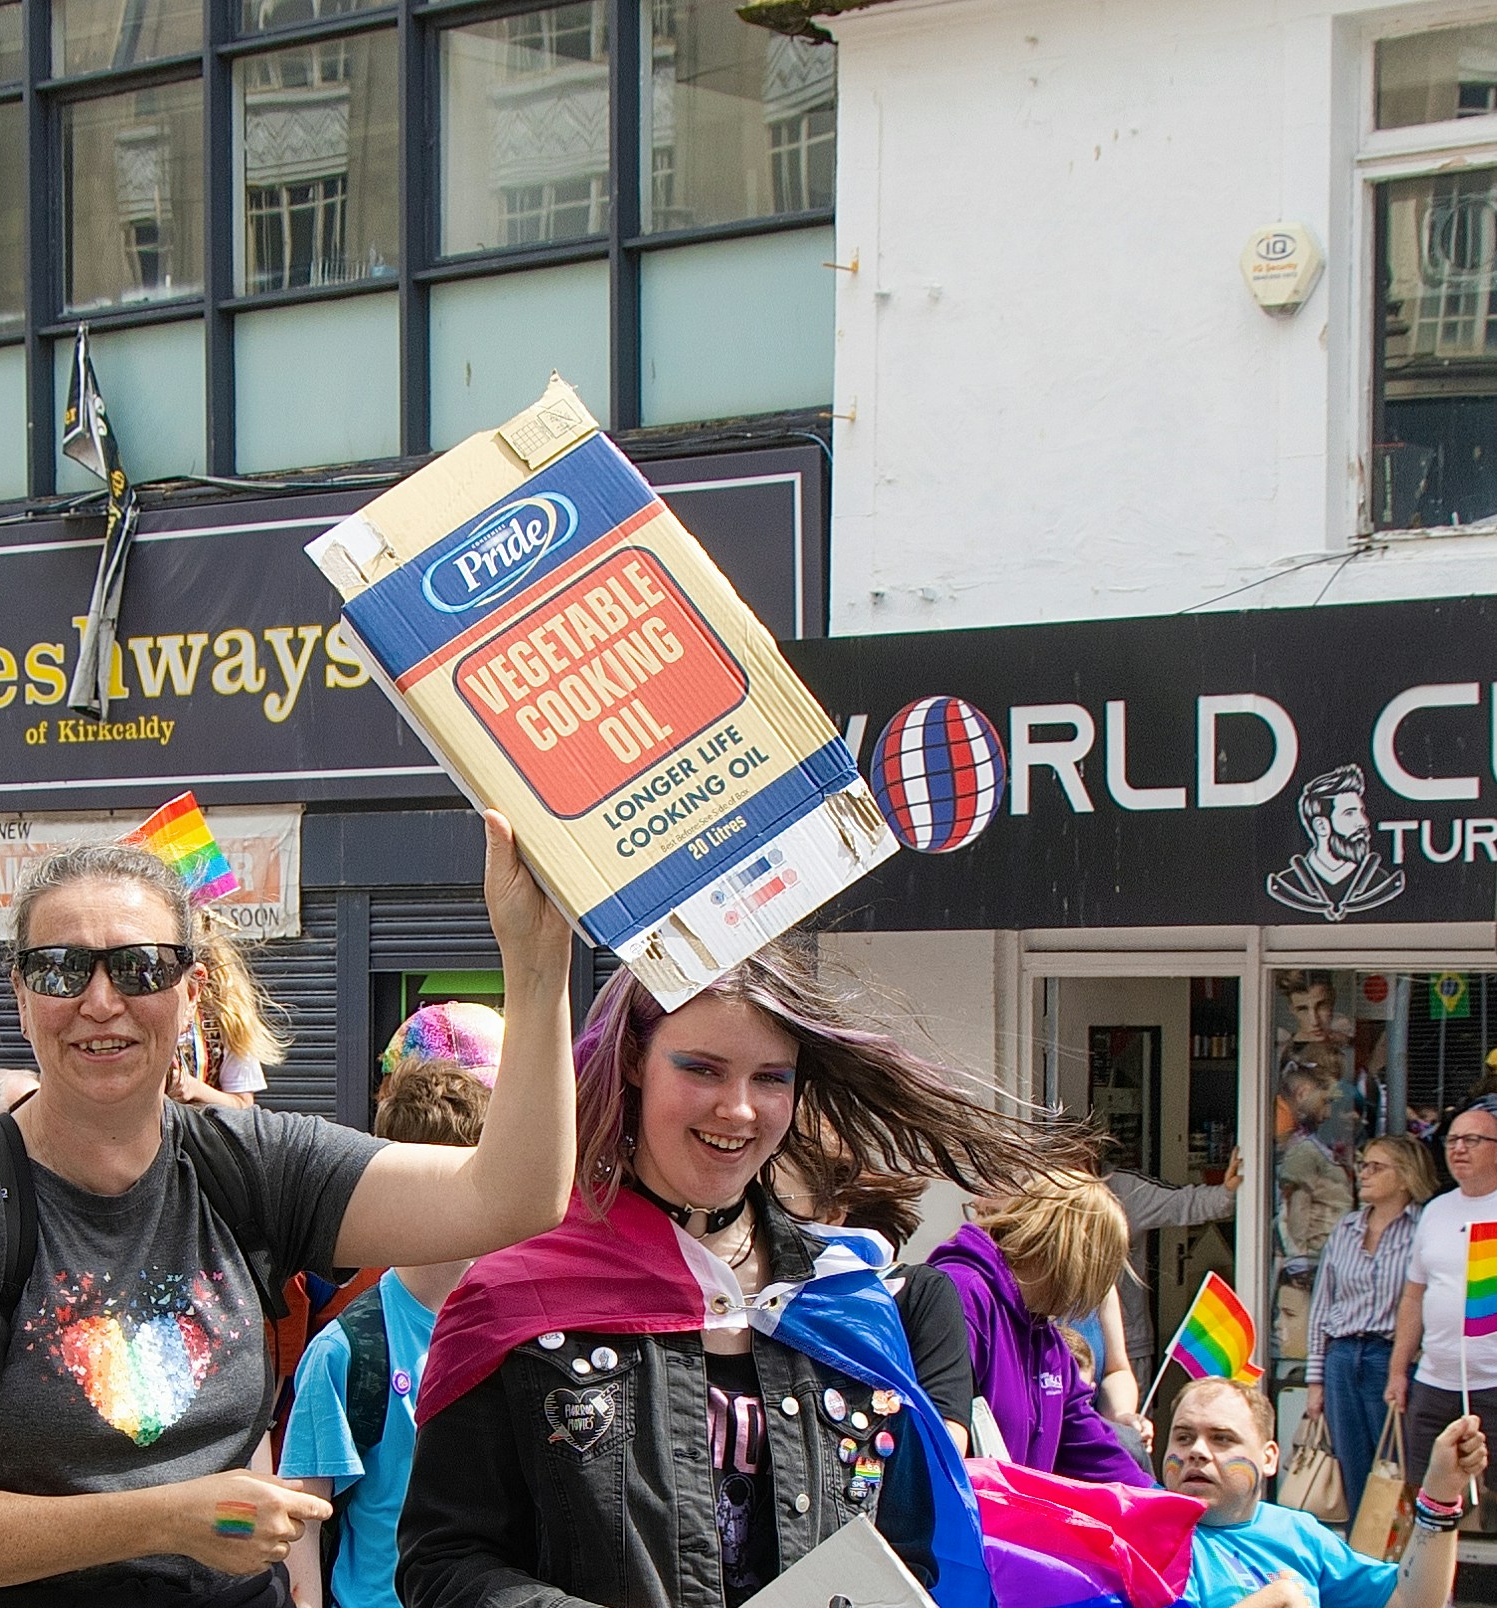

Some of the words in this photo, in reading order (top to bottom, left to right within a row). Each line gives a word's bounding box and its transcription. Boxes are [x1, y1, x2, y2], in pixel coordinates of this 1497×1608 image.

[452, 517, 548, 593] Pride
[464, 560, 667, 716] VEGETABLE
[514, 616, 686, 753] COOKING
[25, 720, 49, 745] of
[58, 715, 176, 746] Kirkcaldy
[598, 698, 674, 765] OIL
[1372, 681, 1497, 801] C
[602, 757, 700, 831] LONGER
[696, 724, 744, 765] LIFE
[616, 774, 726, 858] COOKING
[728, 746, 771, 779] OIL
[660, 839, 678, 854] Best
[735, 787, 750, 801] Box
[687, 837, 710, 861] 20
[705, 814, 748, 848] Litres
[229, 904, 280, 928] SOON
[567, 1416, 594, 1432] MOVIES
